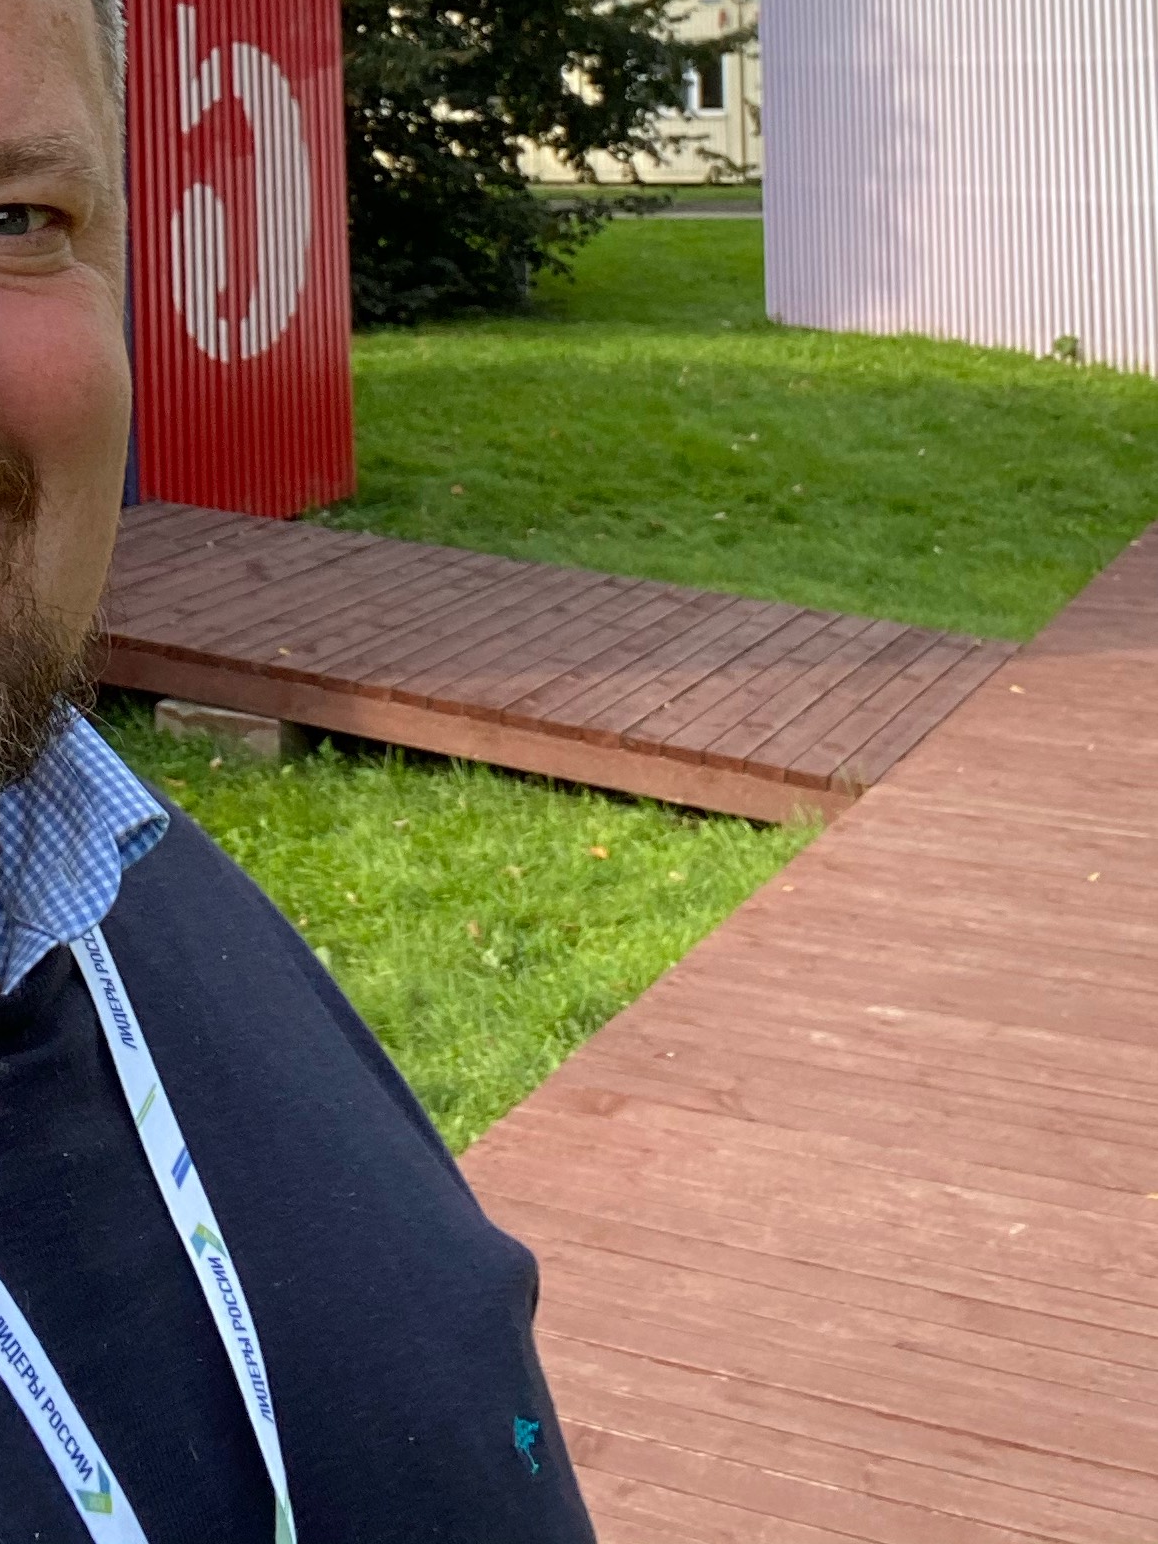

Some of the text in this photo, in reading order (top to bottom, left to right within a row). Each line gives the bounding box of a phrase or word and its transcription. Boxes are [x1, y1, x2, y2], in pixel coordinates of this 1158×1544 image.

[82, 928, 138, 1051] ЛИДЕРЫ РОСС
[207, 1256, 274, 1424] ЛИДЕРЫ РОССИИ
[41, 1397, 93, 1483] РОССИИ
